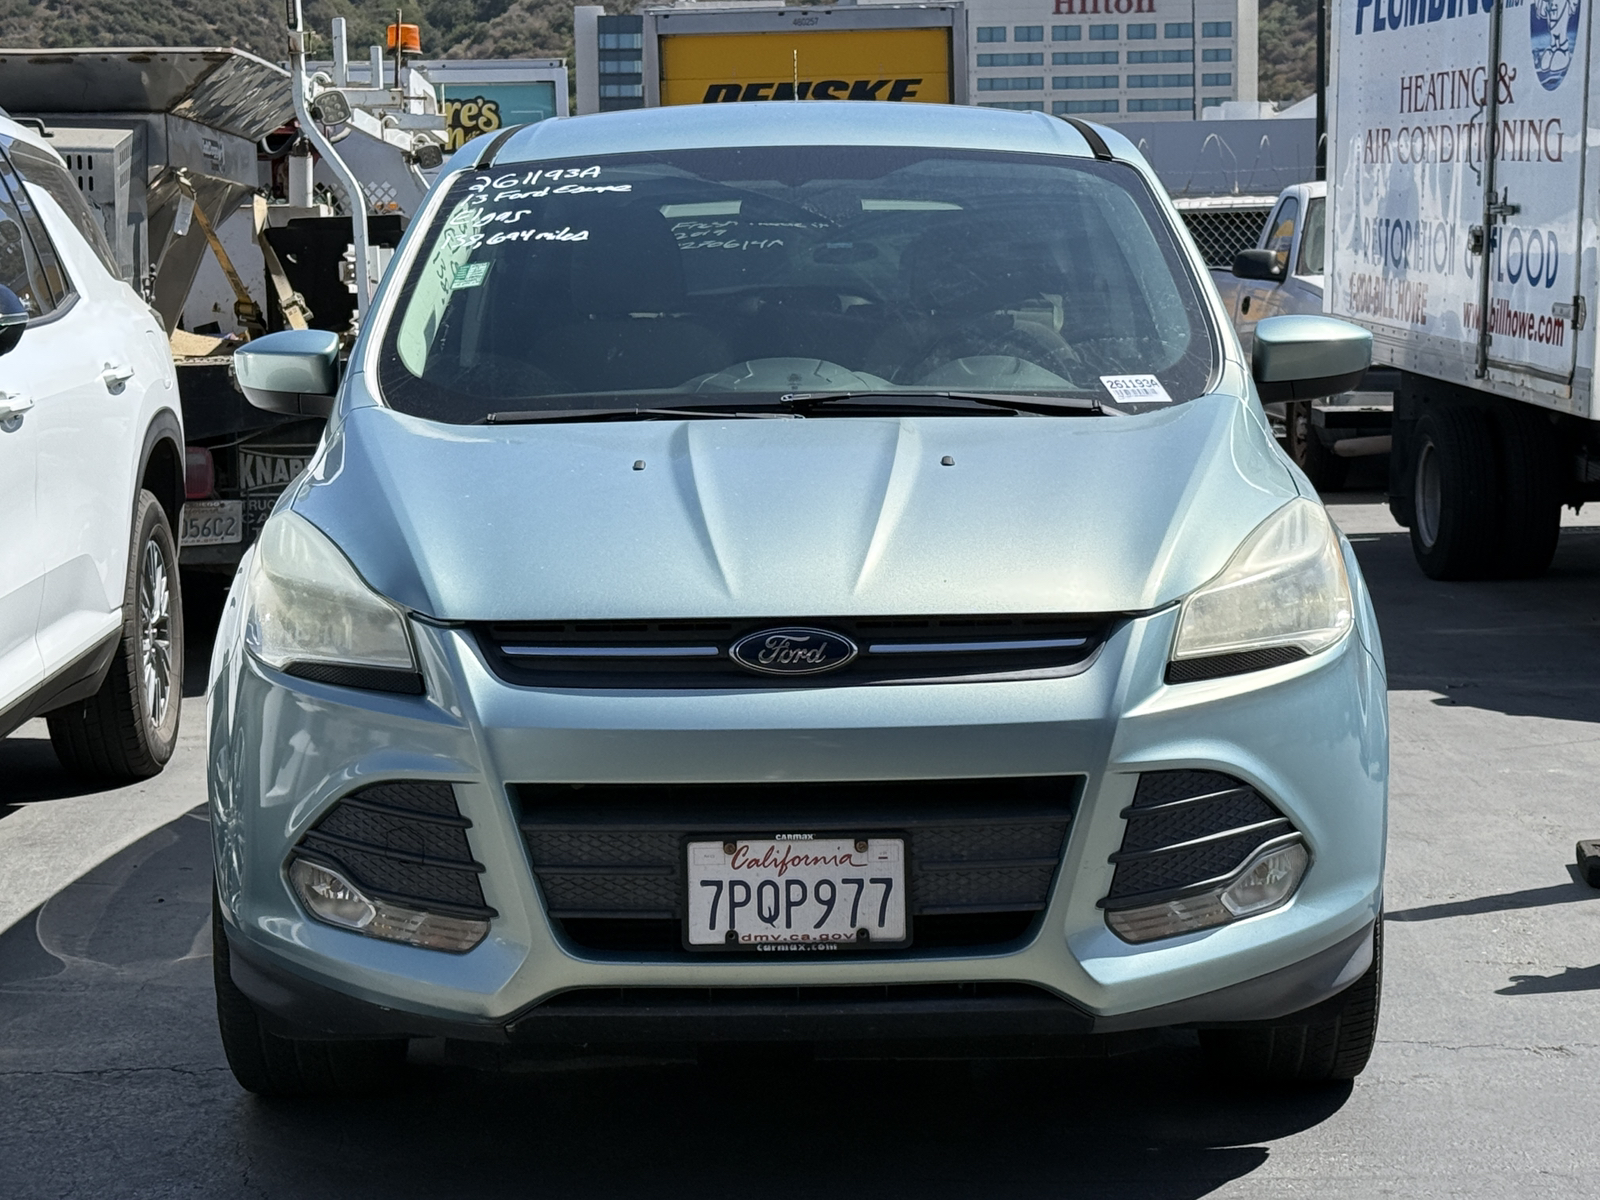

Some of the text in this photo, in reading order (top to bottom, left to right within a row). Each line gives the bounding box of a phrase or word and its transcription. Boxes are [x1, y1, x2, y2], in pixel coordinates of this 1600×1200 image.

[1052, 0, 1157, 14] Hilton
[1399, 62, 1517, 114] HEATING &
[1363, 118, 1564, 164] AIR CONDITIONING
[494, 186, 550, 202] Ford
[535, 227, 589, 241] miles
[1463, 297, 1564, 347] ww.billhowe.com
[239, 452, 310, 490] KNAP
[242, 499, 276, 511] TRUC
[757, 634, 838, 664] Ford
[731, 844, 868, 877] California
[700, 877, 893, 931] 7PQP977
[741, 931, 856, 943] dmv.ca.gov
[756, 942, 838, 952] carmax.com
